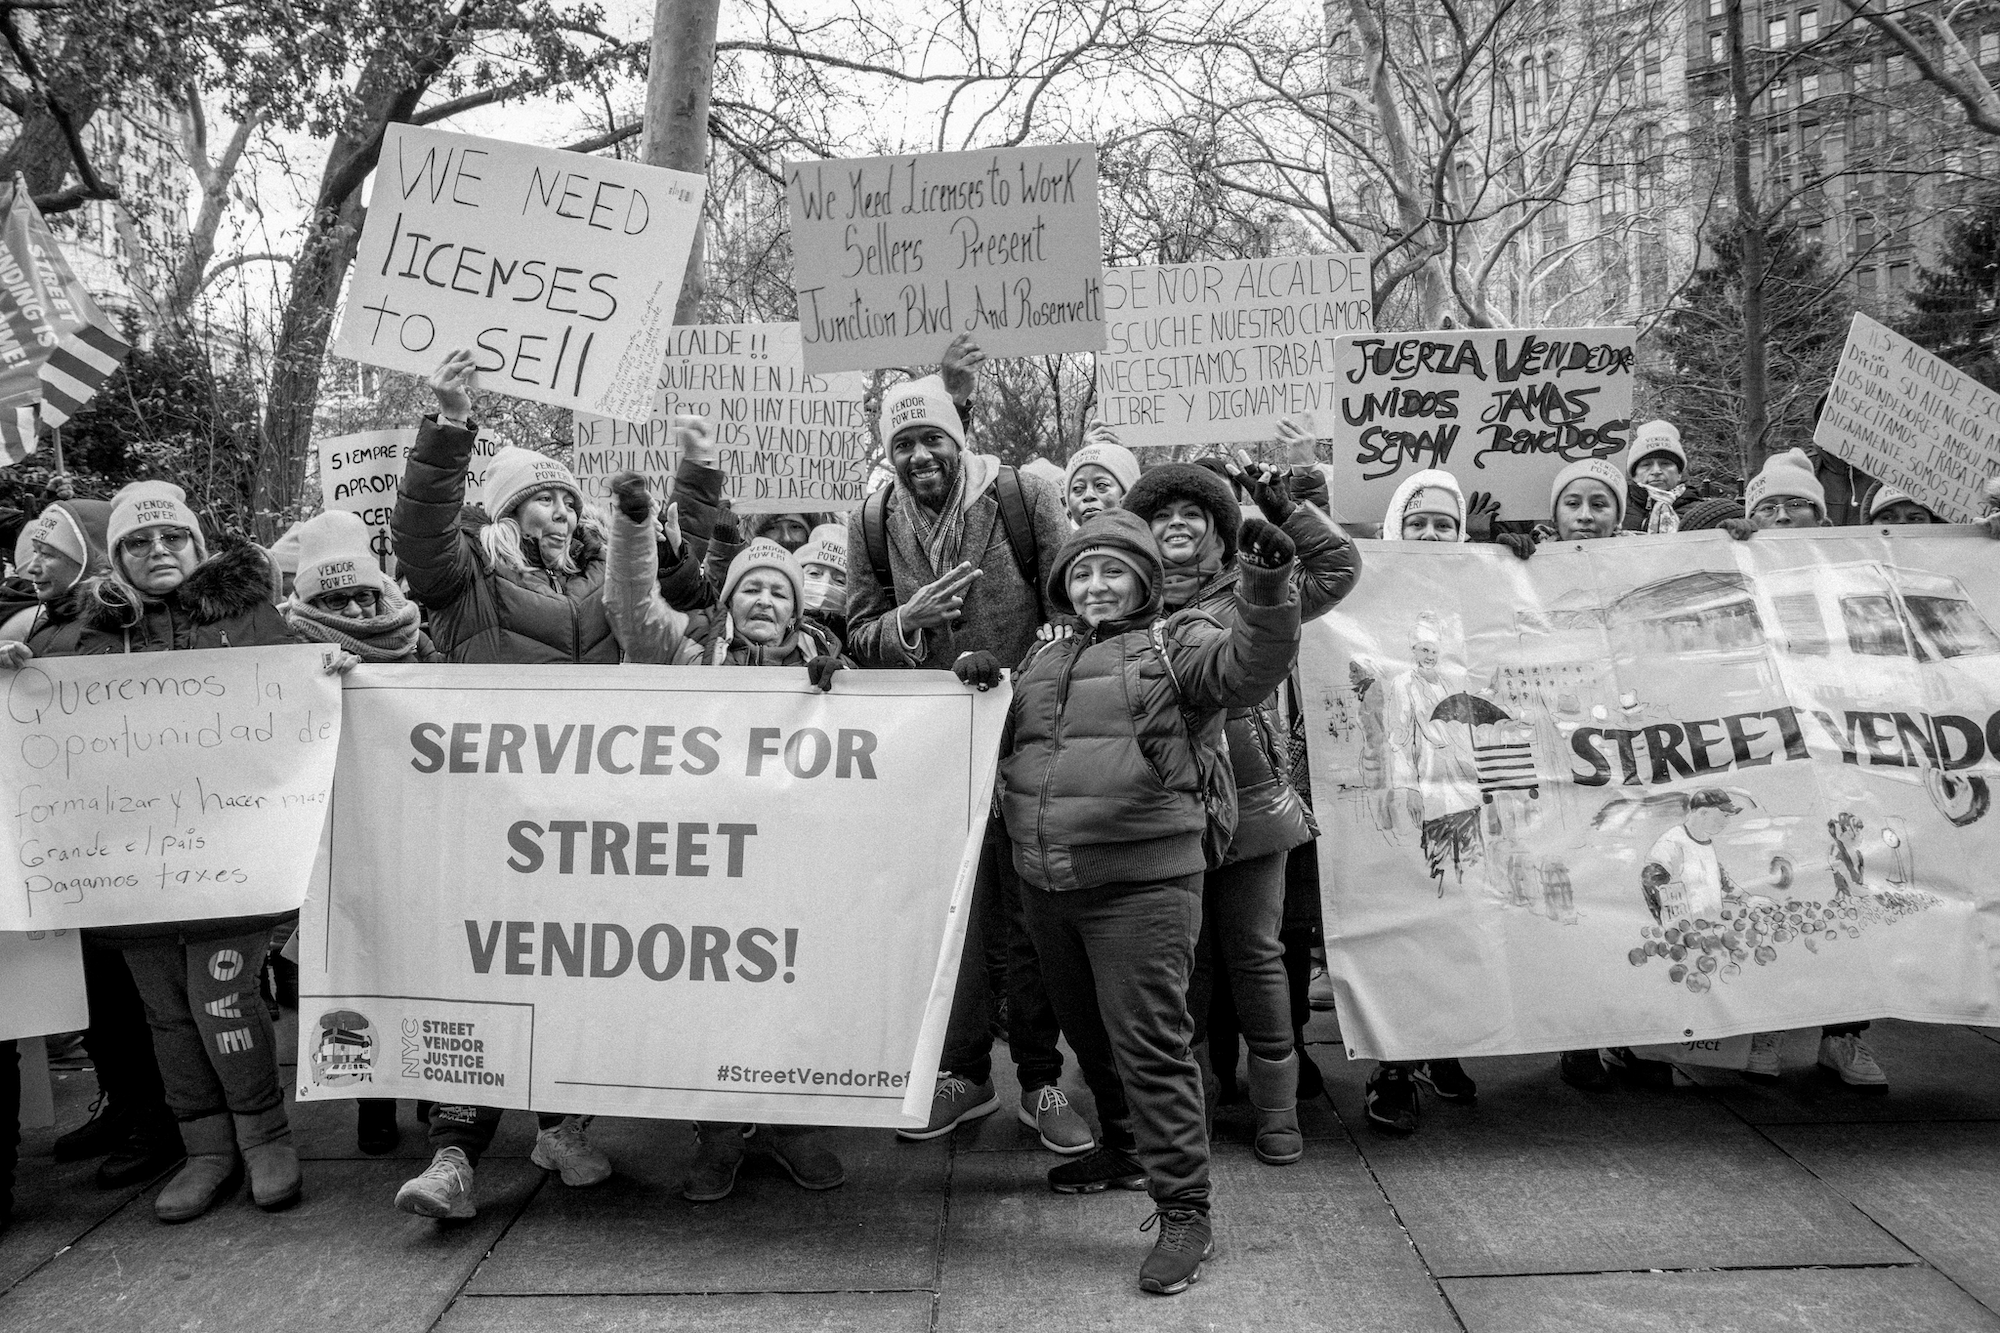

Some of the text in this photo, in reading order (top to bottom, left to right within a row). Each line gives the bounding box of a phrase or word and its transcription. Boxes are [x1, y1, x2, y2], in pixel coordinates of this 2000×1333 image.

[399, 136, 649, 235] WE NEED
[792, 166, 836, 221] We
[846, 164, 893, 219] Need
[1019, 157, 1081, 204] Work
[841, 214, 1047, 278] Sellers Present
[27, 244, 80, 326] STREET
[1235, 257, 1366, 301] ALCALDE
[799, 286, 897, 344] Junction
[899, 279, 952, 337] Blvd
[965, 280, 1008, 331] And
[1100, 300, 1371, 356] SCUCHE NUESTRO CLAMOR
[32, 325, 59, 347] IS
[665, 330, 741, 357] LCALDE
[753, 366, 780, 392] EN
[788, 367, 829, 393] LAS
[1100, 338, 1335, 393] NECESITAMOS TRABAJ
[1902, 347, 1966, 401] ALCALDE
[1968, 389, 2000, 424] ESC
[665, 392, 710, 416] Pero
[721, 398, 747, 421] NO
[754, 398, 783, 422] HAY
[789, 398, 865, 429] FUENTES
[890, 396, 925, 415] VENDOR
[1103, 382, 1335, 427] LIBRE Y DIGNAMENT
[1342, 382, 1601, 427] UNIDOS JAMAS
[1839, 365, 1862, 390] LOS
[1865, 379, 1940, 441] VENDEDORES
[1897, 377, 1918, 400] SU
[331, 444, 398, 470] SIEMPRE
[472, 439, 495, 457] NTO
[578, 422, 603, 448] DE
[716, 423, 750, 446] LOS
[756, 426, 866, 460] VENDEDORES
[1832, 385, 1984, 493] NESECITAMOS TRABAJA
[577, 450, 681, 477] AMBULANT
[719, 449, 794, 477] PAGAMOS
[1839, 439, 1857, 460] DE
[1861, 453, 1927, 502] NUESTROS
[1907, 456, 1949, 496] SOMOS
[1953, 487, 1972, 511] EL
[134, 500, 176, 512] VENDOR
[335, 474, 398, 501] APROPI
[576, 476, 613, 498] TOS
[721, 476, 748, 498] RTE
[755, 477, 774, 499] DE
[778, 477, 798, 499] LA
[317, 561, 356, 576] VENDOR
[817, 551, 848, 566] POWER
[8, 663, 282, 724] Queremos la
[21, 710, 331, 779] Oportunidad de
[409, 722, 878, 780] SERVICES FOR
[1570, 706, 2000, 788] STREET VEND
[15, 785, 160, 838] formalizar
[196, 777, 268, 815] hacer
[20, 831, 110, 868] Grande
[125, 825, 151, 855] el
[506, 820, 758, 877] STREET
[155, 863, 248, 889] taxes
[464, 919, 799, 984] VENDORS!
[204, 949, 254, 1054] OVE
[402, 1018, 420, 1078] NYC
[422, 1020, 475, 1036] STREET
[423, 1036, 484, 1053] VENDOR
[423, 1052, 484, 1069] JUSTICE
[423, 1067, 505, 1087] COALITION
[717, 1065, 911, 1088] #StreetVendorRef
